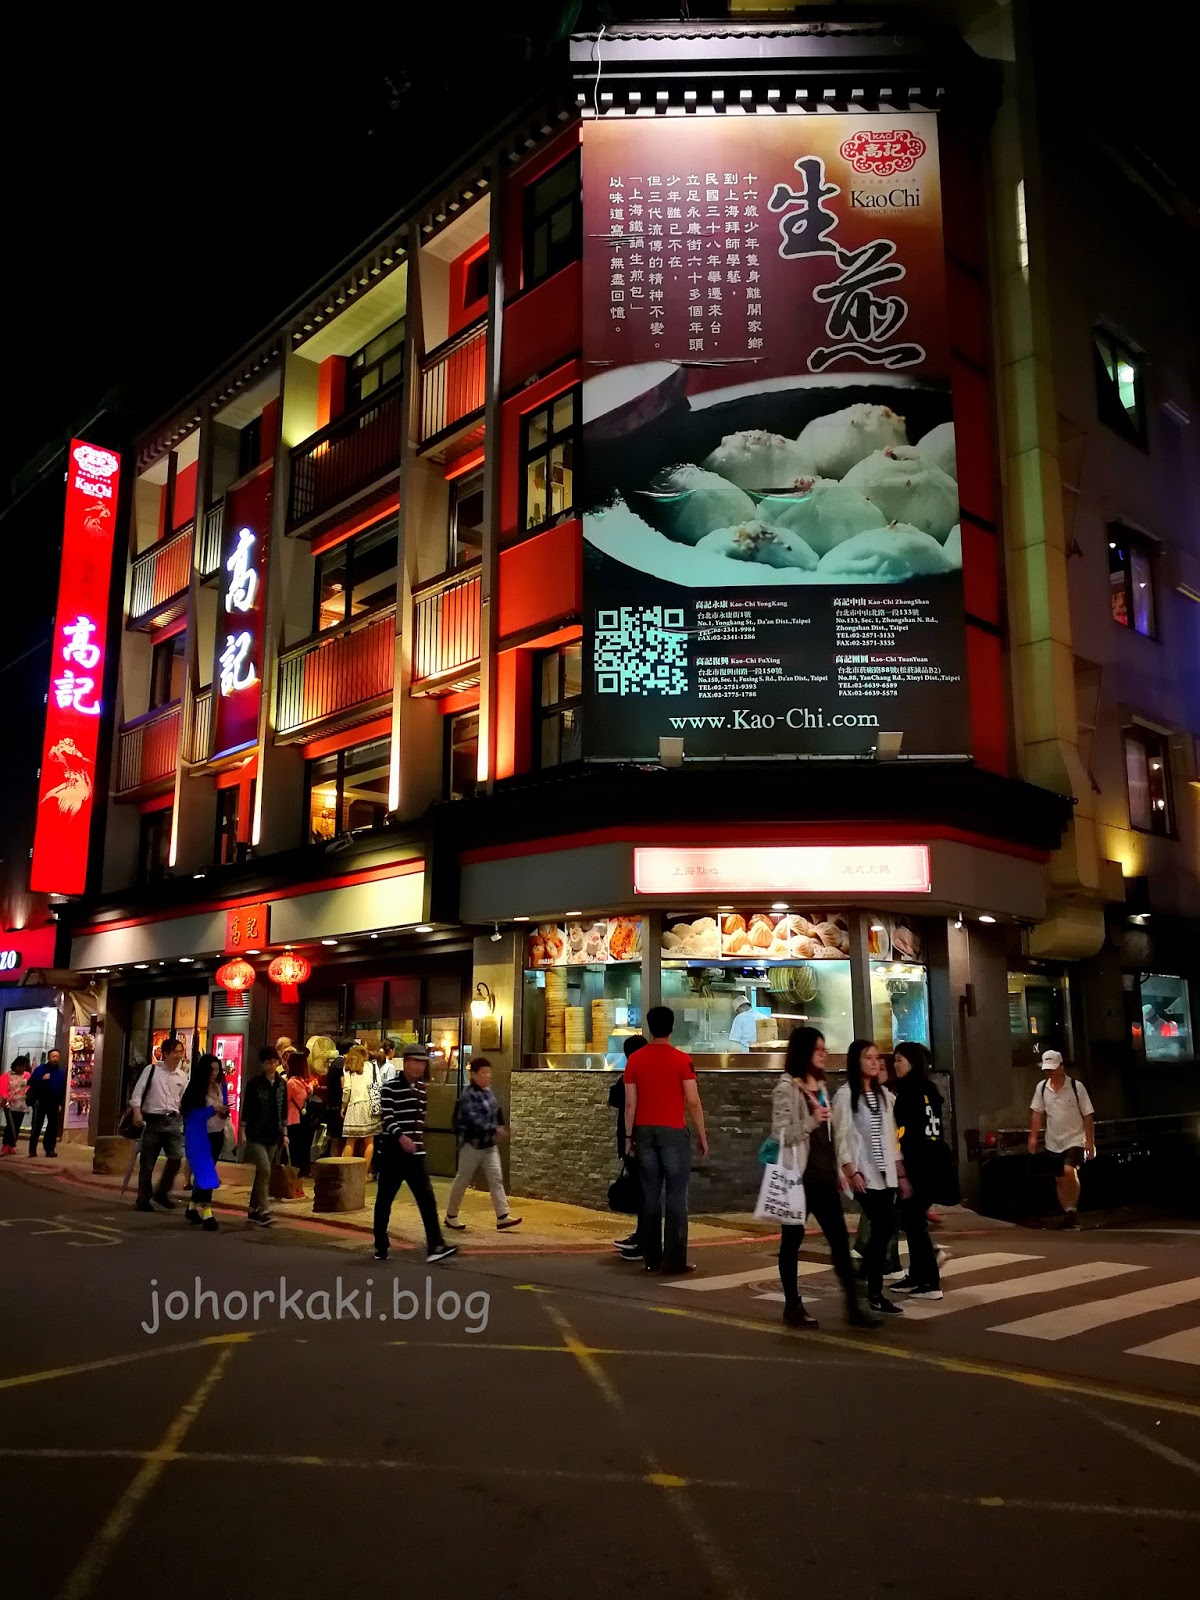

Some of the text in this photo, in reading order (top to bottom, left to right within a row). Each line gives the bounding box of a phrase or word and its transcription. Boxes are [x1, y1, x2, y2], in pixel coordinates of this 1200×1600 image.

[862, 142, 905, 158] 高記
[850, 188, 921, 208] KaoChi
[666, 174, 683, 282] 少年雖已不在，
[723, 172, 741, 297] 到上海拜師學藝，
[647, 174, 665, 349] 但三代流傳的精神不變。
[686, 174, 704, 352] 立足永康街六十多個年頭
[767, 155, 927, 373] 生煎
[219, 527, 258, 698] 高記
[696, 600, 728, 610] 高記永康
[756, 600, 788, 608] YongKang
[715, 619, 745, 627] Yongkang
[835, 624, 870, 632] Zhongshan
[889, 624, 909, 632] Taipei
[54, 615, 101, 716] 高記
[696, 656, 729, 666] 高記復興
[757, 657, 781, 665] FuXing
[739, 675, 758, 684] Fuxing
[809, 674, 828, 682] Taipei
[837, 674, 859, 682] No.88,
[860, 674, 891, 682] YanChang
[906, 674, 923, 682] Xinyi
[669, 708, 880, 730] www.Kao-Chi.com
[672, 866, 720, 876] 上海點心
[231, 915, 259, 946] 高記
